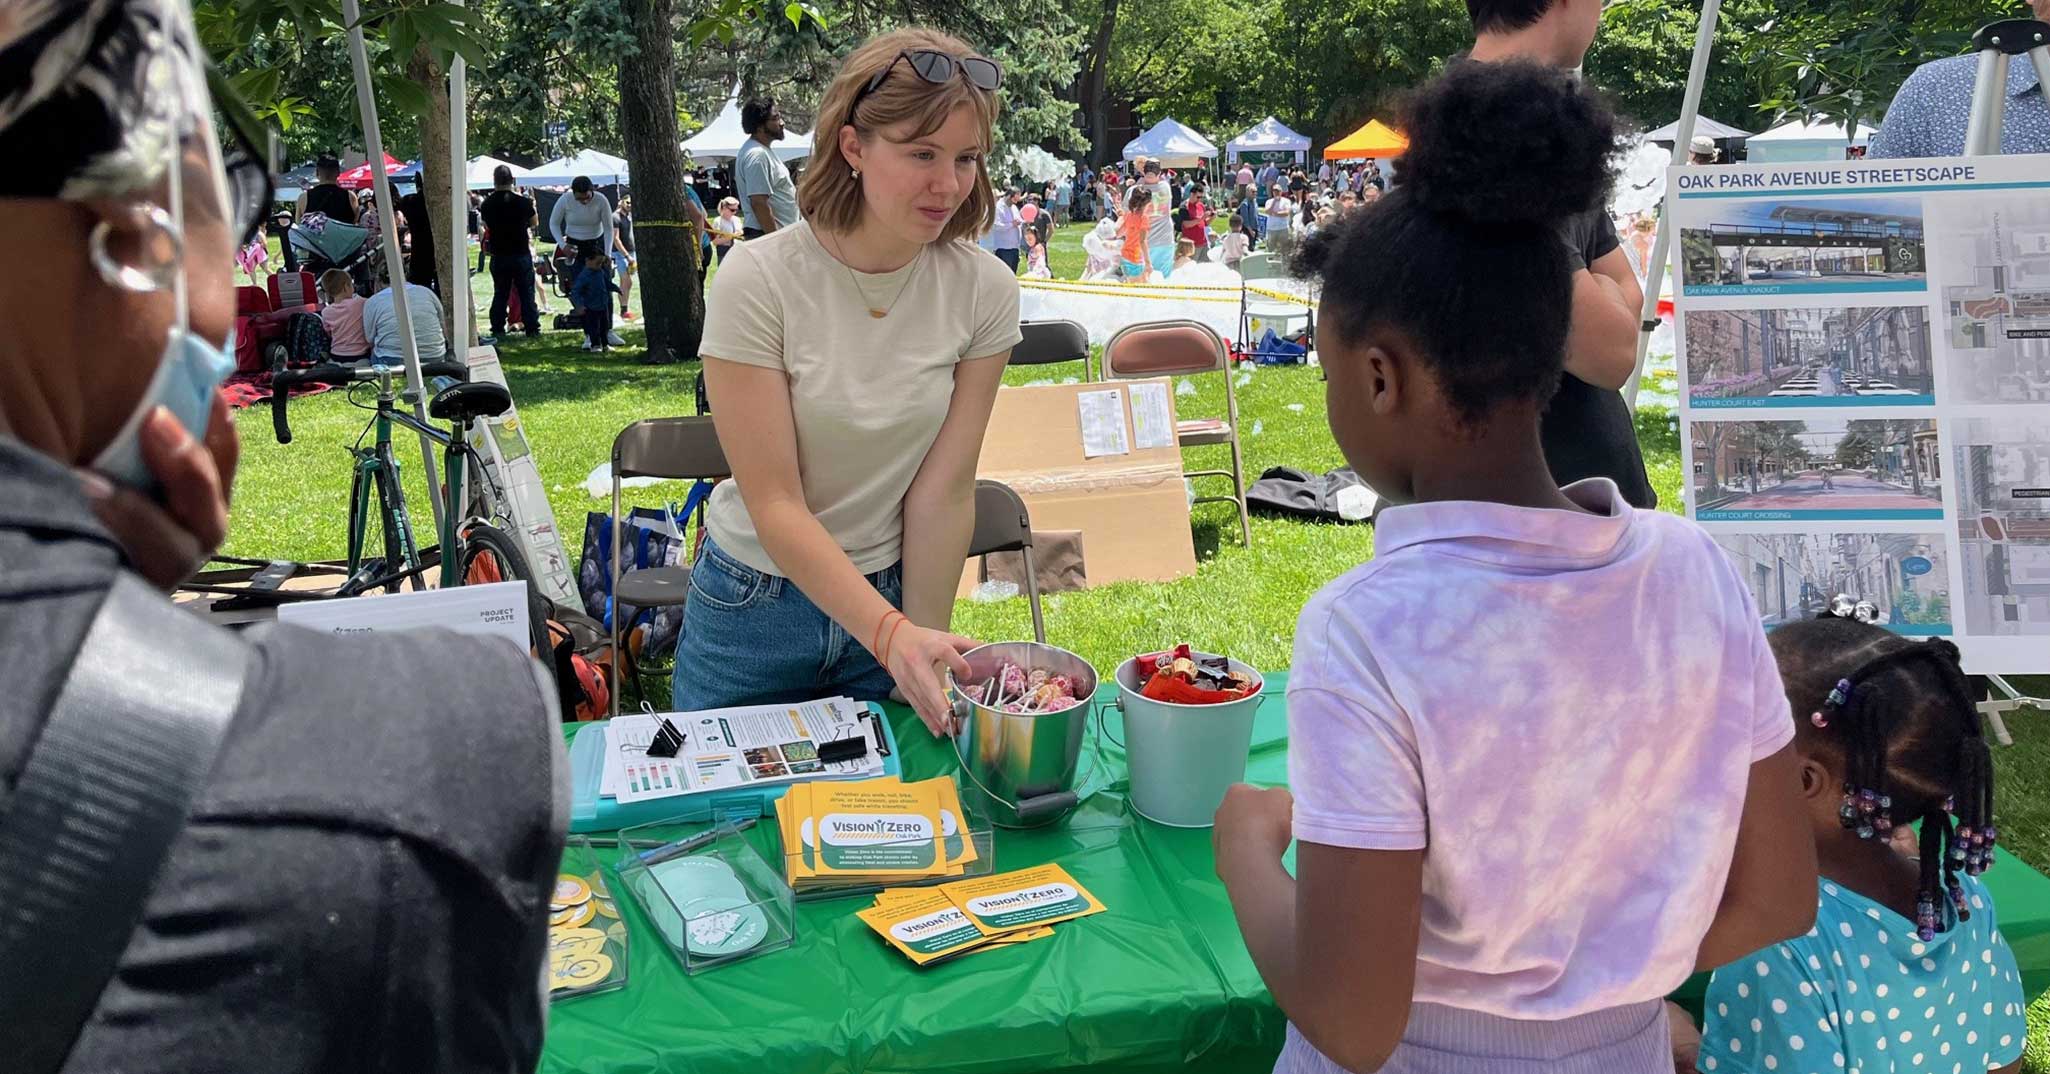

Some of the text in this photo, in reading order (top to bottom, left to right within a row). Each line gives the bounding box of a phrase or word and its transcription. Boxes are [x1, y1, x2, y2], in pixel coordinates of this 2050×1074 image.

[1678, 166, 1975, 189] OAK PARK AVENUE STREETSCAPE
[1702, 286, 1719, 295] PARK
[1720, 286, 1748, 294] AVENUE
[1691, 399, 1720, 407] HUNTER
[1722, 399, 1746, 407] COURT
[1728, 511, 1753, 519] COURT
[1754, 511, 1792, 519] CROSSING
[480, 608, 514, 617] PROJECT
[484, 615, 514, 623] UPDATE
[832, 821, 922, 833] VISION ZERO
[978, 887, 1064, 908] VISION ZERO
[902, 917, 944, 934] VISION
